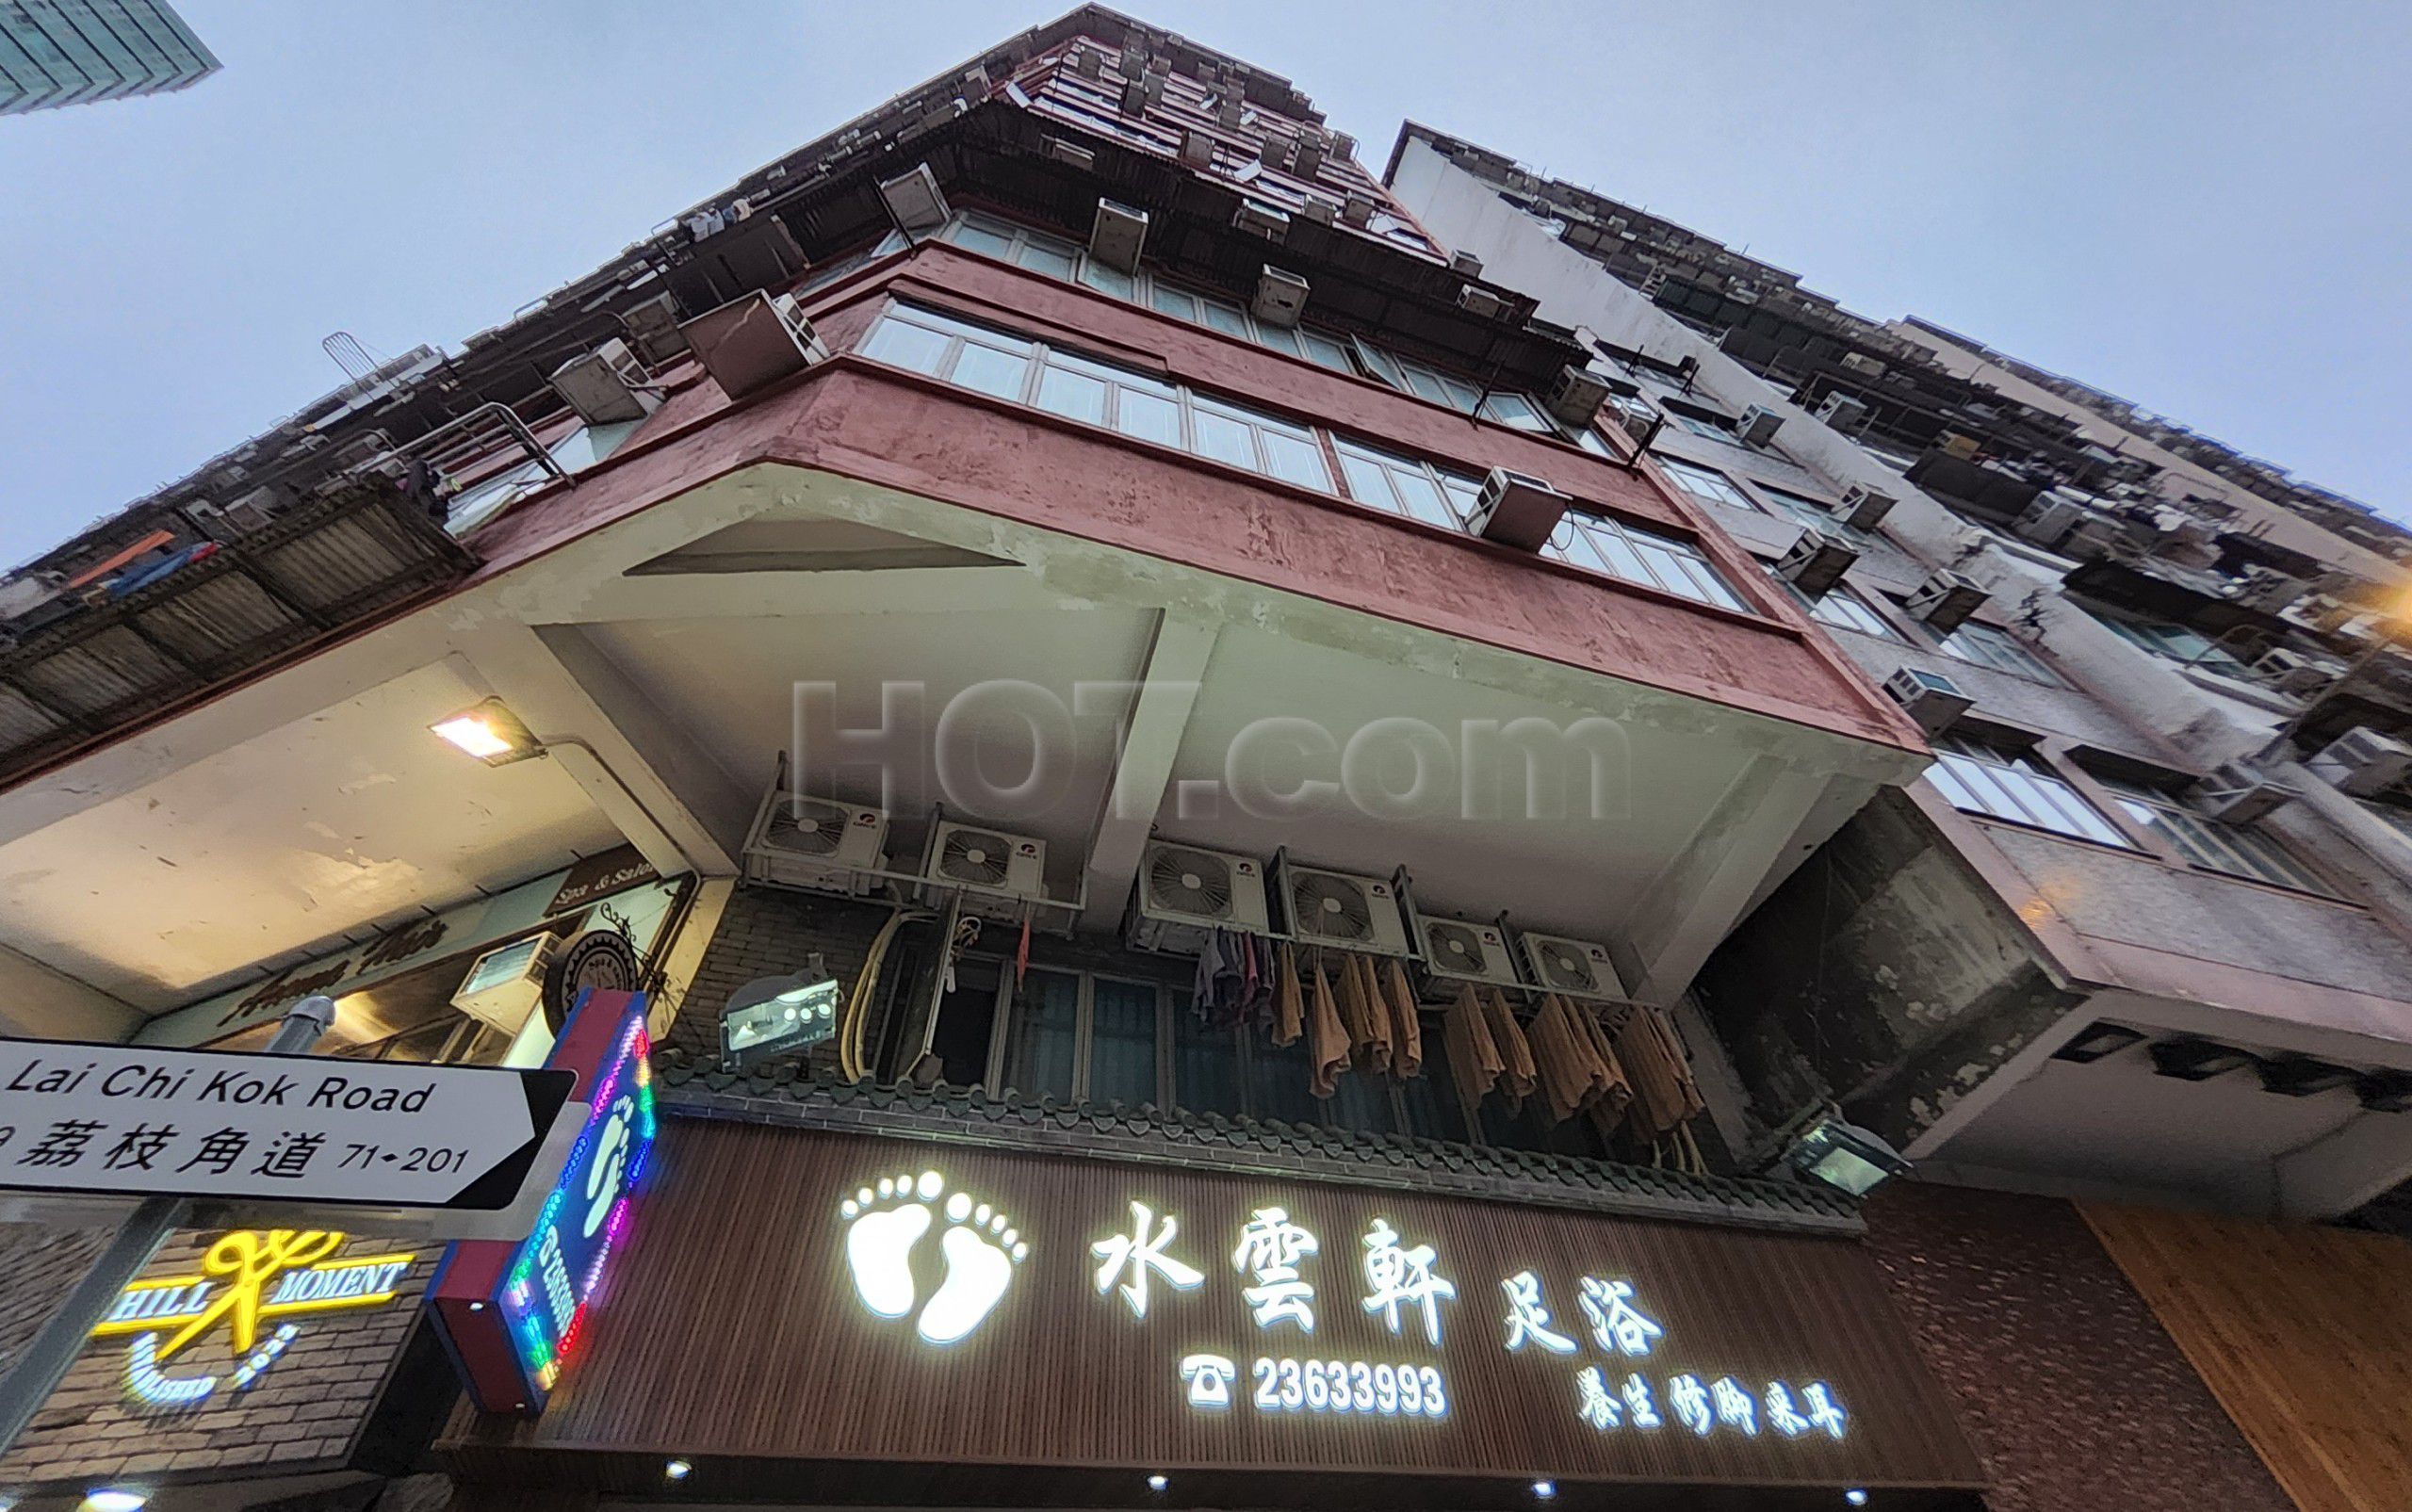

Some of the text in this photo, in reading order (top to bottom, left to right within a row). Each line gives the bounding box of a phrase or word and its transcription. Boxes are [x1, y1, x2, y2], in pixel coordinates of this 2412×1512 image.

[6, 1059, 437, 1114] Lai Chi Kok Road
[17, 1118, 327, 1179] 荔枝角道
[105, 1261, 411, 1323] HILL MOMENT
[1090, 1199, 1458, 1347] 水雲軒
[1252, 1357, 1447, 1418] 23633993
